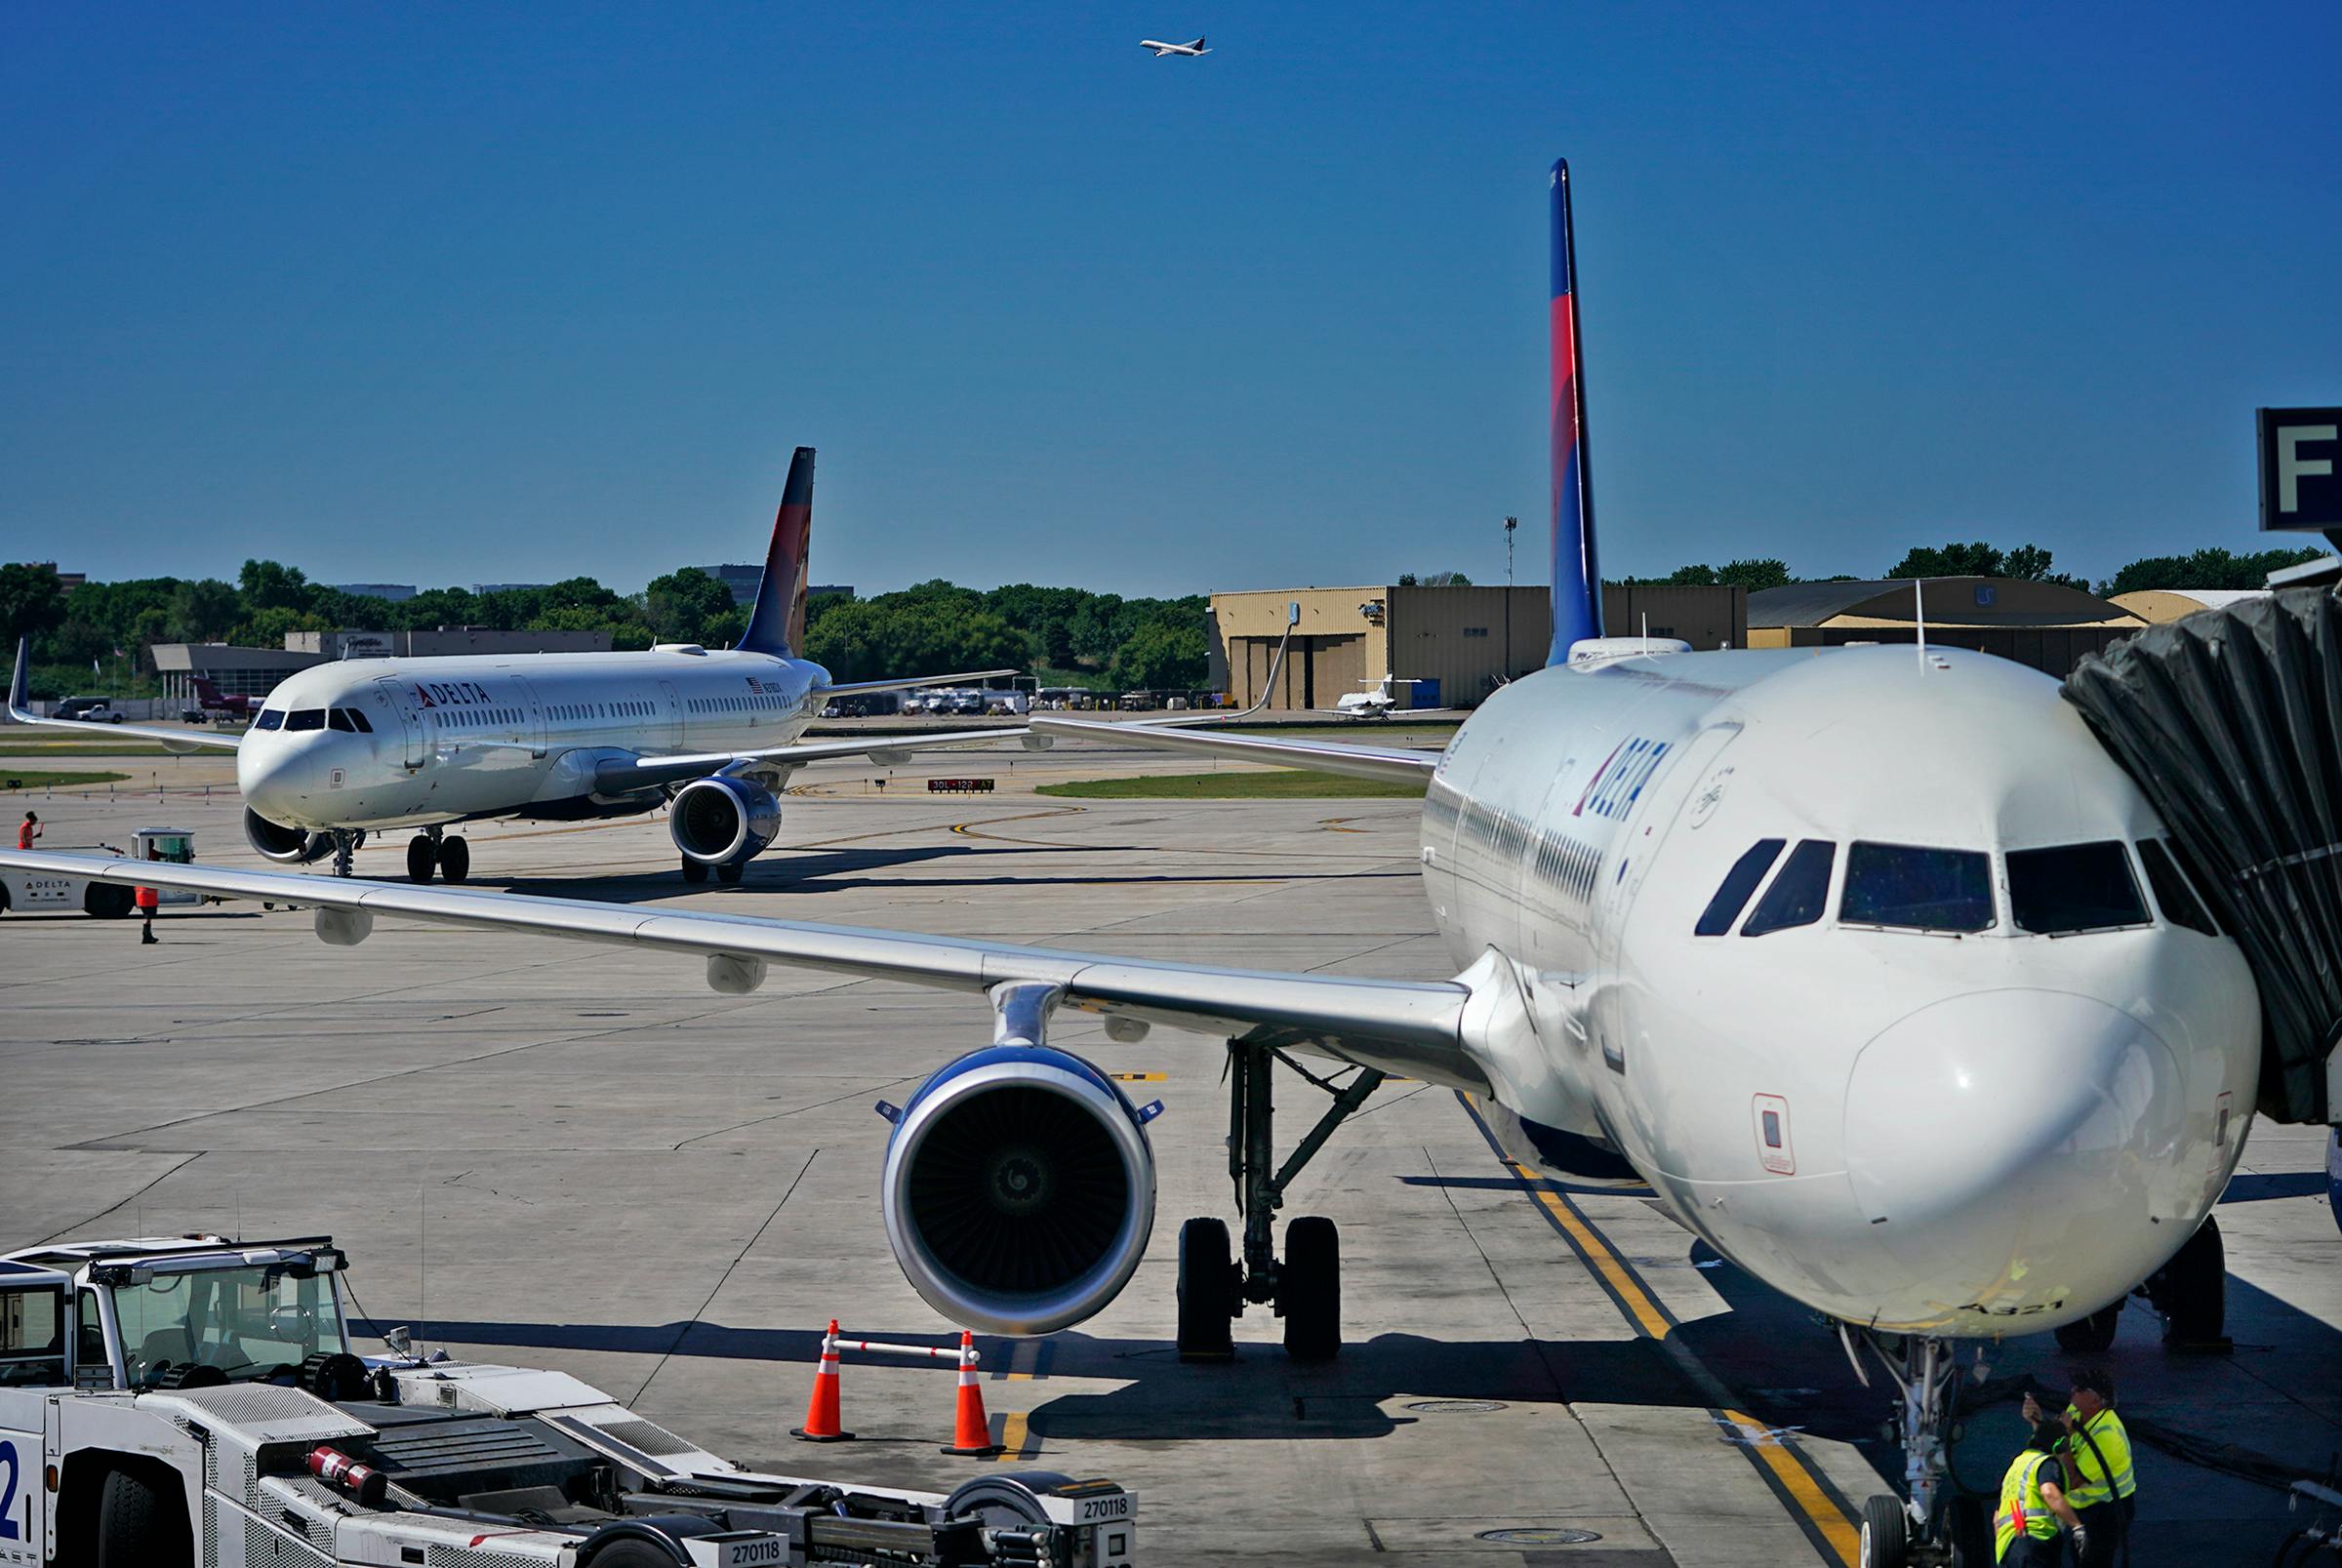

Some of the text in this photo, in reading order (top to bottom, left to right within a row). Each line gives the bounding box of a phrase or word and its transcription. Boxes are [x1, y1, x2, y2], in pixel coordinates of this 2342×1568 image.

[2277, 424, 2338, 513] F
[429, 682, 492, 704] DELTA
[1958, 1300, 2064, 1316] A321
[1084, 1498, 1128, 1519] 270118
[732, 1542, 780, 1564] 270118
